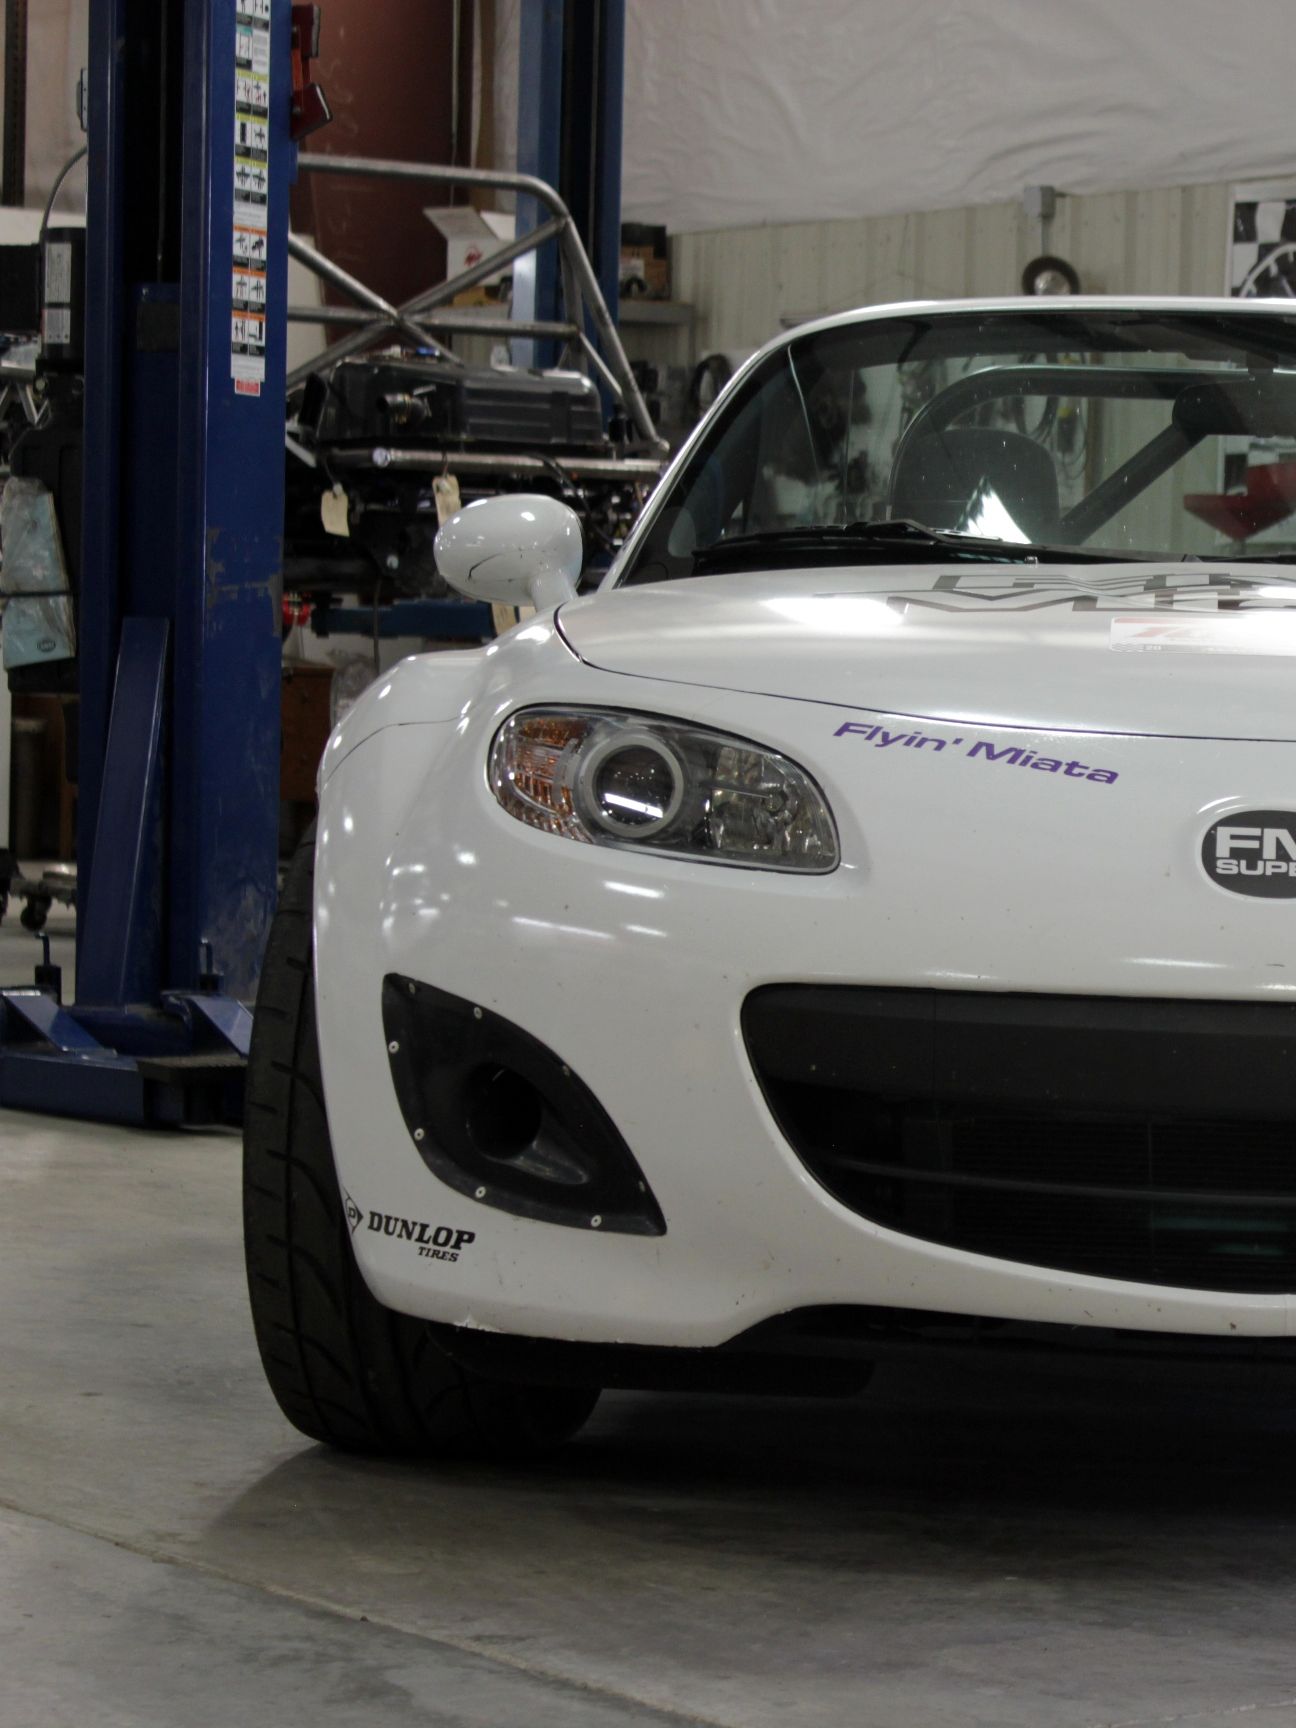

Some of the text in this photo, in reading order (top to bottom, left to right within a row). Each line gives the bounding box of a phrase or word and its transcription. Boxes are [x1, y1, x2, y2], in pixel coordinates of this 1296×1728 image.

[832, 721, 1120, 785] Flyin' Miata
[367, 1210, 477, 1251] DUNLOP
[417, 1246, 460, 1263] TIRES
